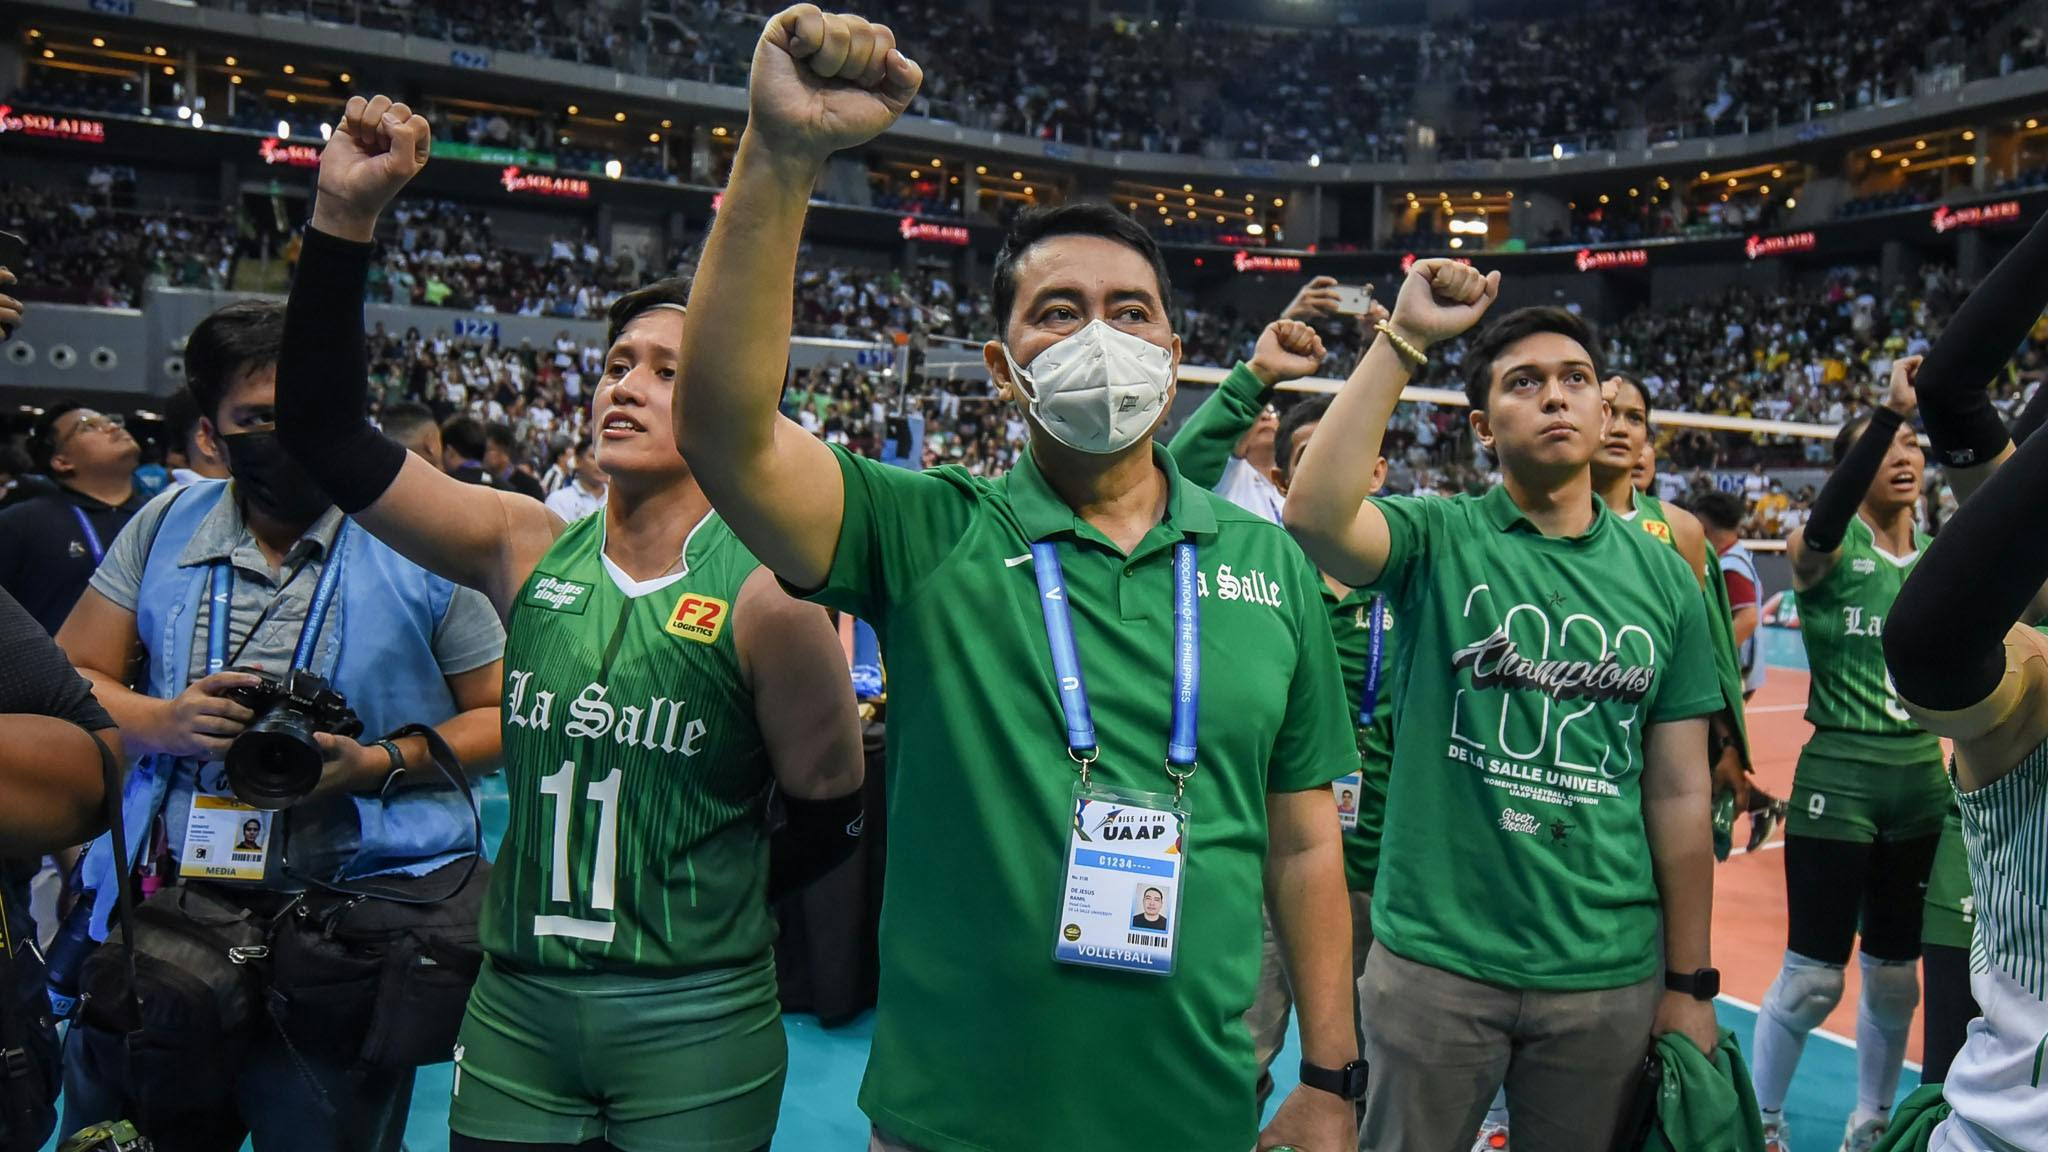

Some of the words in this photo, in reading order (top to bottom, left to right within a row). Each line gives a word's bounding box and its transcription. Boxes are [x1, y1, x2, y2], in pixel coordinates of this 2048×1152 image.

[22, 114, 104, 137] SOLAIRE
[535, 577, 585, 595] phelps
[1182, 545, 1191, 606] ASSOCIATION
[1216, 563, 1282, 608] Salle
[534, 588, 577, 609] dodge
[676, 598, 721, 630] F2
[1183, 608, 1191, 621] OF
[1843, 606, 1882, 637] La
[672, 620, 714, 637] LOGISTICS
[1183, 622, 1192, 641] THE
[1181, 642, 1192, 703] PHILIPPINES
[1452, 624, 1655, 702] Champions
[507, 670, 556, 731] La
[565, 682, 707, 757] Salle
[1448, 744, 1468, 761] DE
[1470, 751, 1485, 770] LA
[1488, 759, 1542, 782] SALLE
[1483, 776, 1519, 790] WOMEN'S
[1520, 784, 1567, 799] VOLLEYBALL
[1567, 794, 1599, 805] DIVISION
[1509, 789, 1531, 799] UAAP
[1531, 793, 1563, 805] SEASON
[1502, 807, 1536, 826] Green
[1808, 792, 1826, 820] 9
[540, 760, 622, 911] 11
[1103, 825, 1166, 841] UAAP
[205, 866, 237, 876] MEDIA
[1077, 944, 1153, 965] VOLLEYBALL
